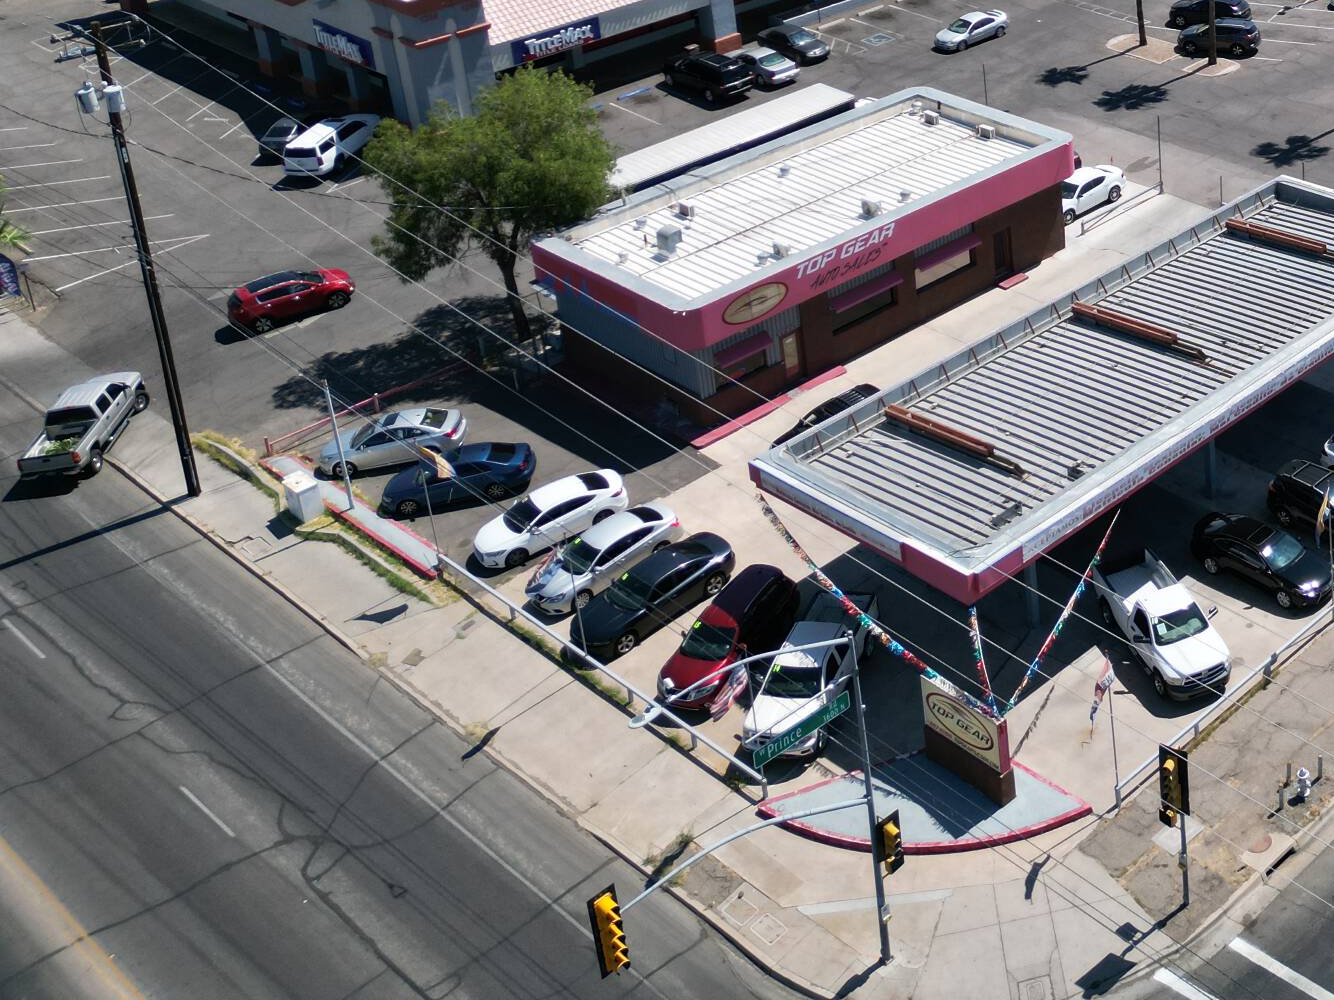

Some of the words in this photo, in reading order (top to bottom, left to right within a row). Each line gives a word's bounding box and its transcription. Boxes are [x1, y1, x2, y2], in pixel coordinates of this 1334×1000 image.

[796, 250, 836, 280] TOP
[839, 222, 895, 260] GEAR
[809, 266, 838, 290] AUTO
[840, 248, 881, 277] SALES
[766, 727, 802, 759] Prince
[929, 701, 954, 721] TOP
[956, 719, 990, 746] GEAR
